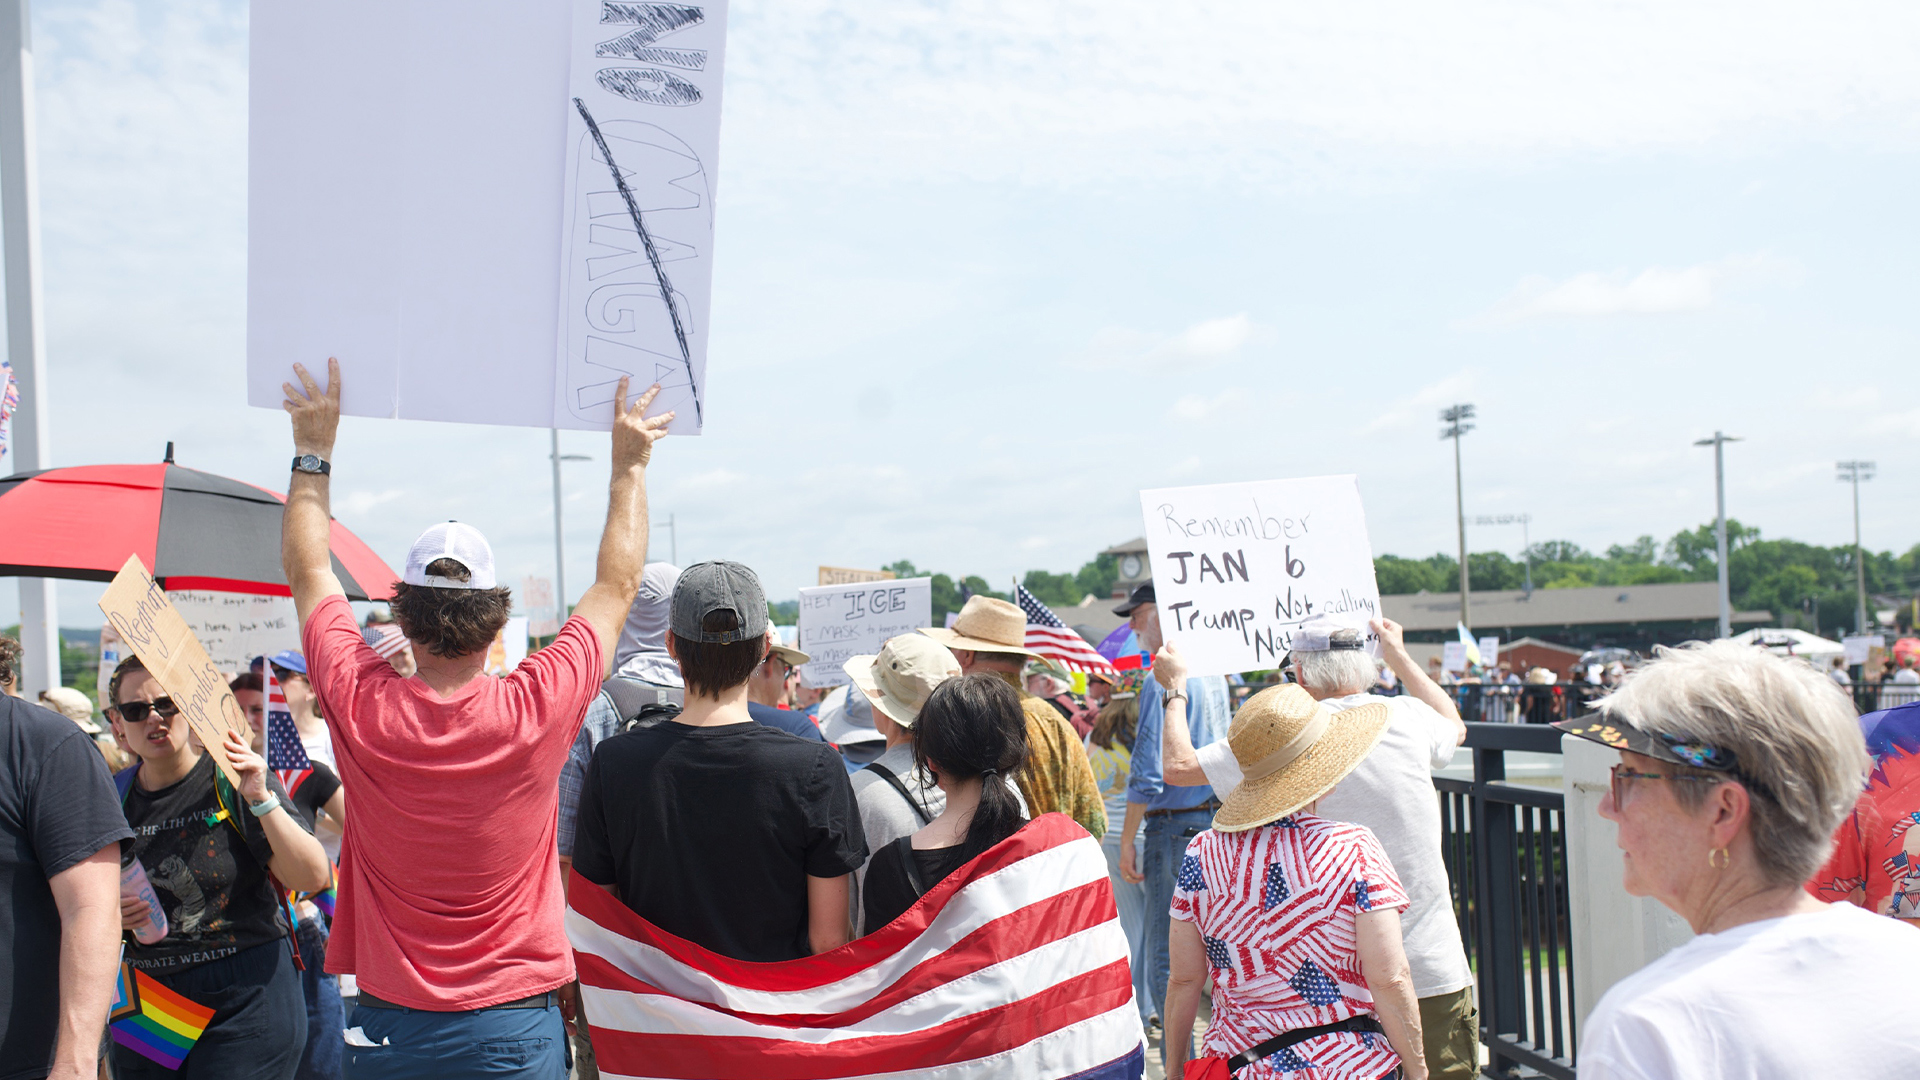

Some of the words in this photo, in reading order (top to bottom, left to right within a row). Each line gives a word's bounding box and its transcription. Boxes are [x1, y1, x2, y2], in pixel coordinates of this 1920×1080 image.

[595, 1, 707, 107] NO
[577, 132, 701, 410] MAGA
[1157, 497, 1311, 540] Remember
[1167, 549, 1249, 584] JAN
[1285, 545, 1305, 579] 6
[803, 594, 834, 609] HEY
[844, 587, 906, 621] ICE
[1168, 600, 1255, 646] Trump
[1276, 585, 1313, 620] Not
[820, 624, 860, 640] MASK
[142, 816, 185, 836] HELTH
